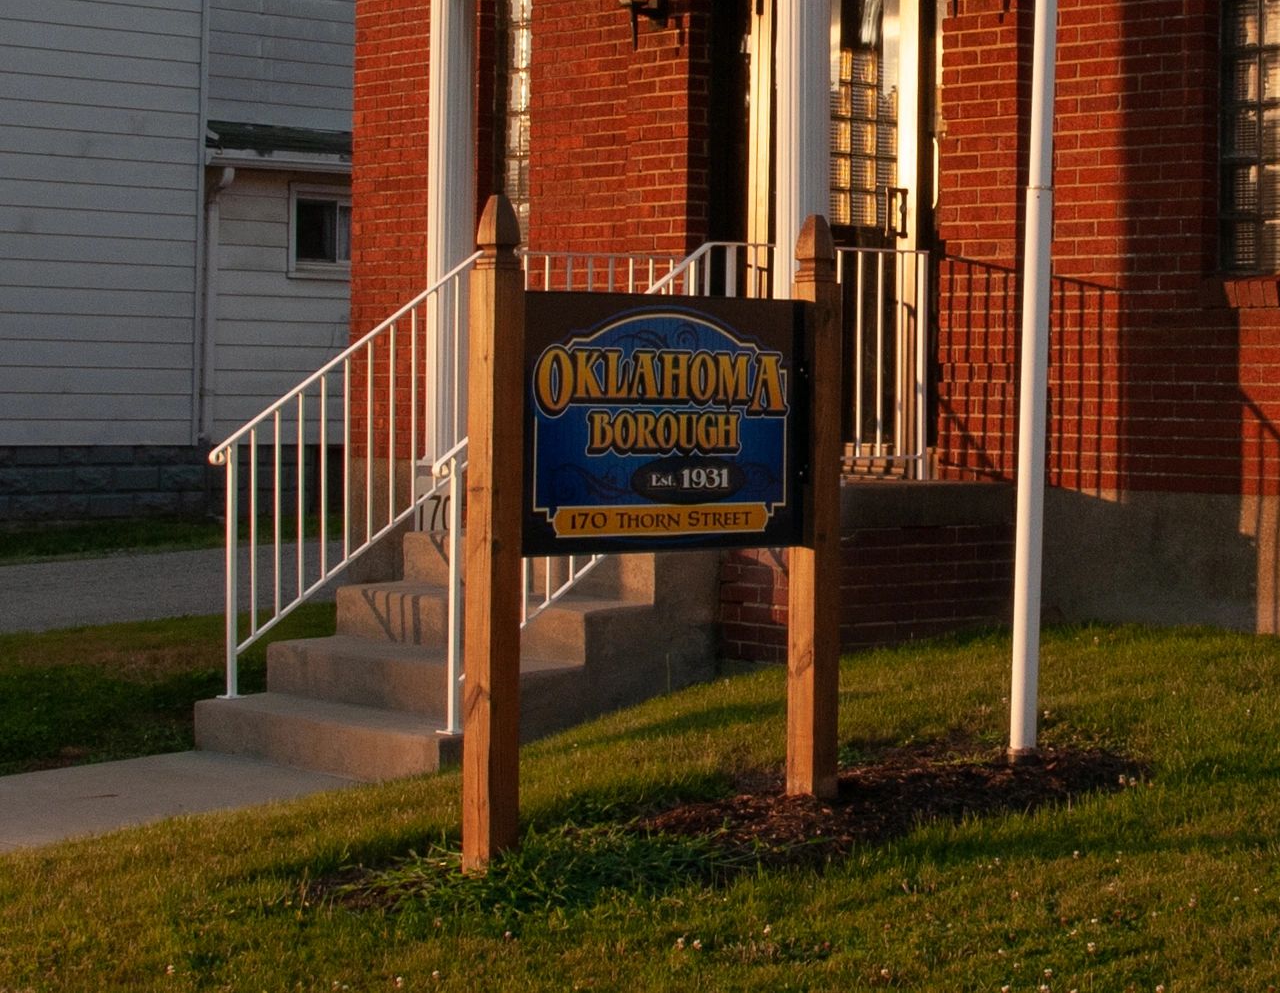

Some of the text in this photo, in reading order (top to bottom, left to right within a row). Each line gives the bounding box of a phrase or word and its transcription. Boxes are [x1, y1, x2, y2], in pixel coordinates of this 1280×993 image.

[535, 347, 788, 415] OKLAHOMA
[588, 411, 740, 453] BOROUGH
[651, 468, 729, 488] Est. 1931
[570, 510, 752, 531] 170 THORN STREET
